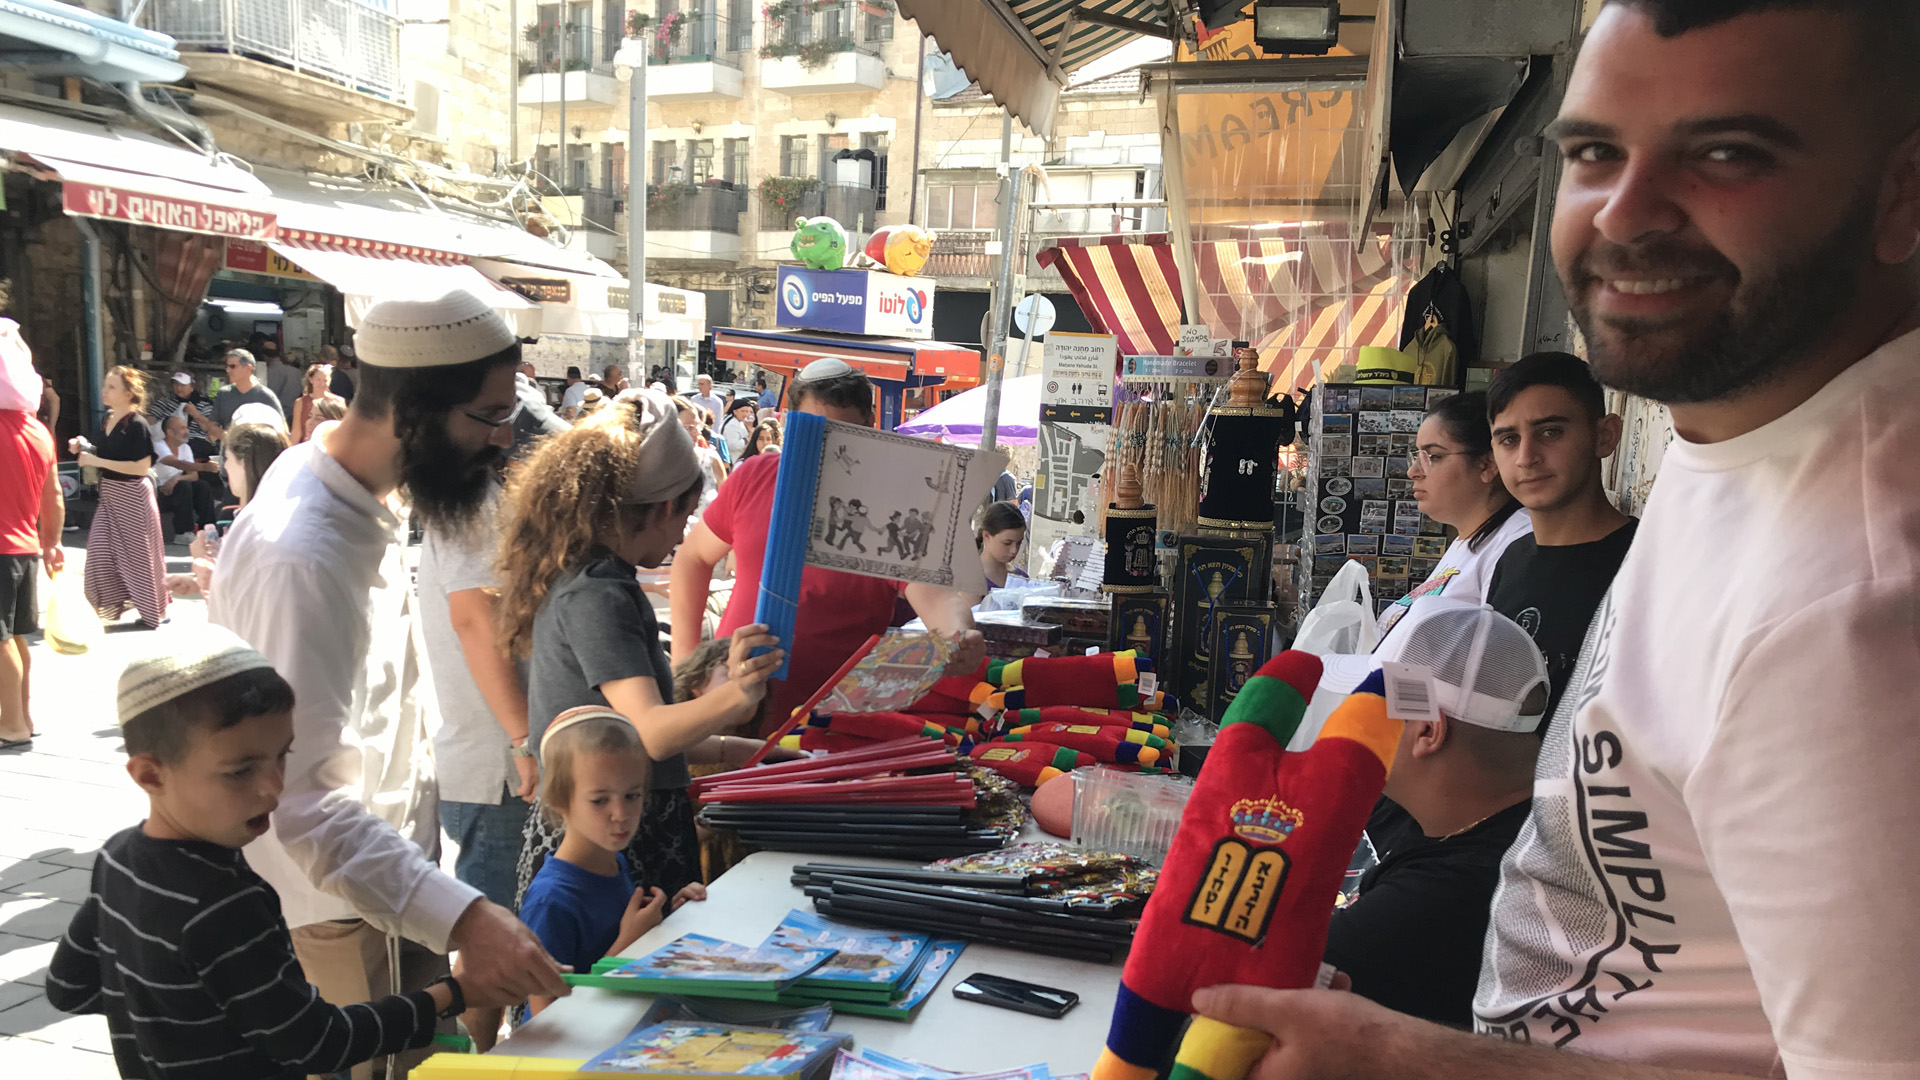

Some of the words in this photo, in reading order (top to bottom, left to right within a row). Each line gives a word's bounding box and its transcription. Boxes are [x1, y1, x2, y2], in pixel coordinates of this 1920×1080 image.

[88, 186, 118, 215] לוי
[128, 195, 197, 228] האחים
[202, 204, 264, 234] פלאפל
[811, 291, 835, 304] הפיס
[835, 292, 863, 305] מפעל
[879, 291, 906, 315] לוטו
[1186, 328, 1198, 336] NO
[1582, 729, 1682, 974] SIMPLY
